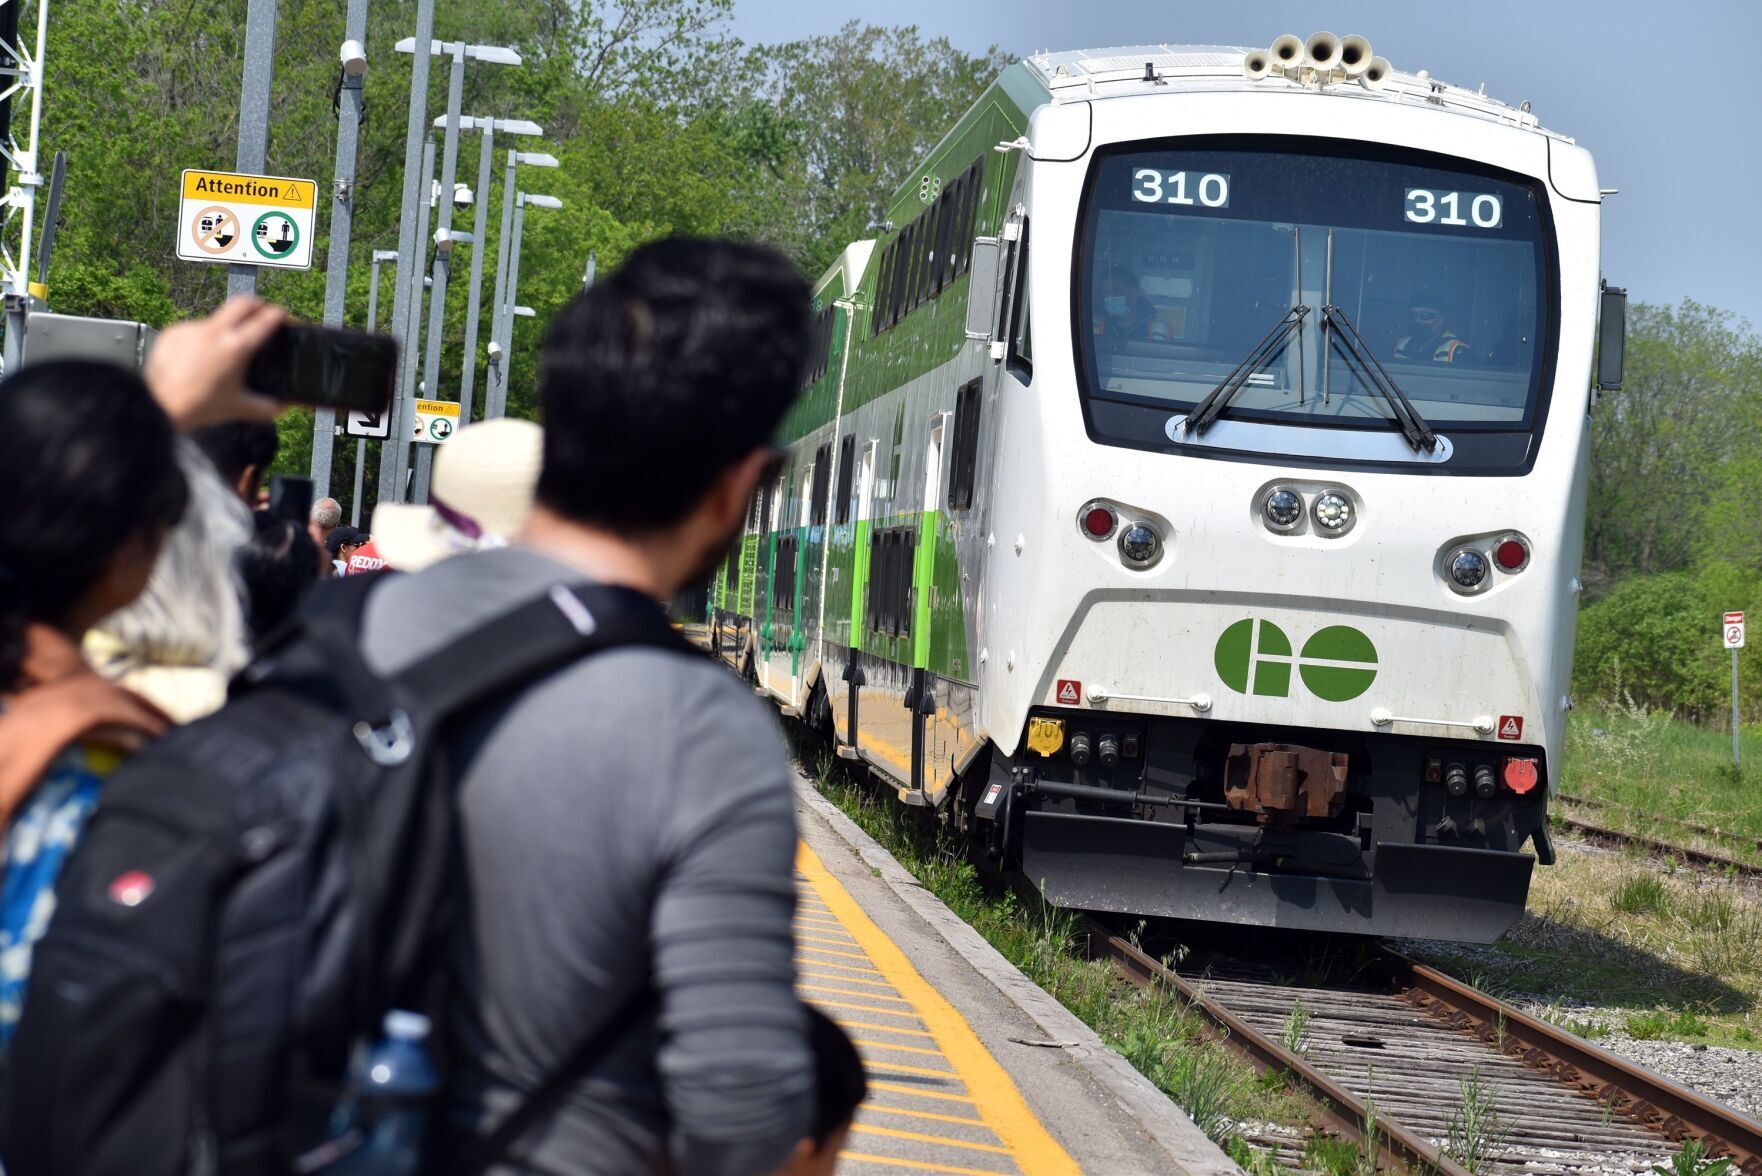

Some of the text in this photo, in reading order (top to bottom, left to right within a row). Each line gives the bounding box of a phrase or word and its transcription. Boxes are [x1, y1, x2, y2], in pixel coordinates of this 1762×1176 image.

[195, 177, 279, 198] Attention
[1133, 169, 1228, 207] 310
[1406, 189, 1501, 228] 310
[417, 403, 444, 412] ention
